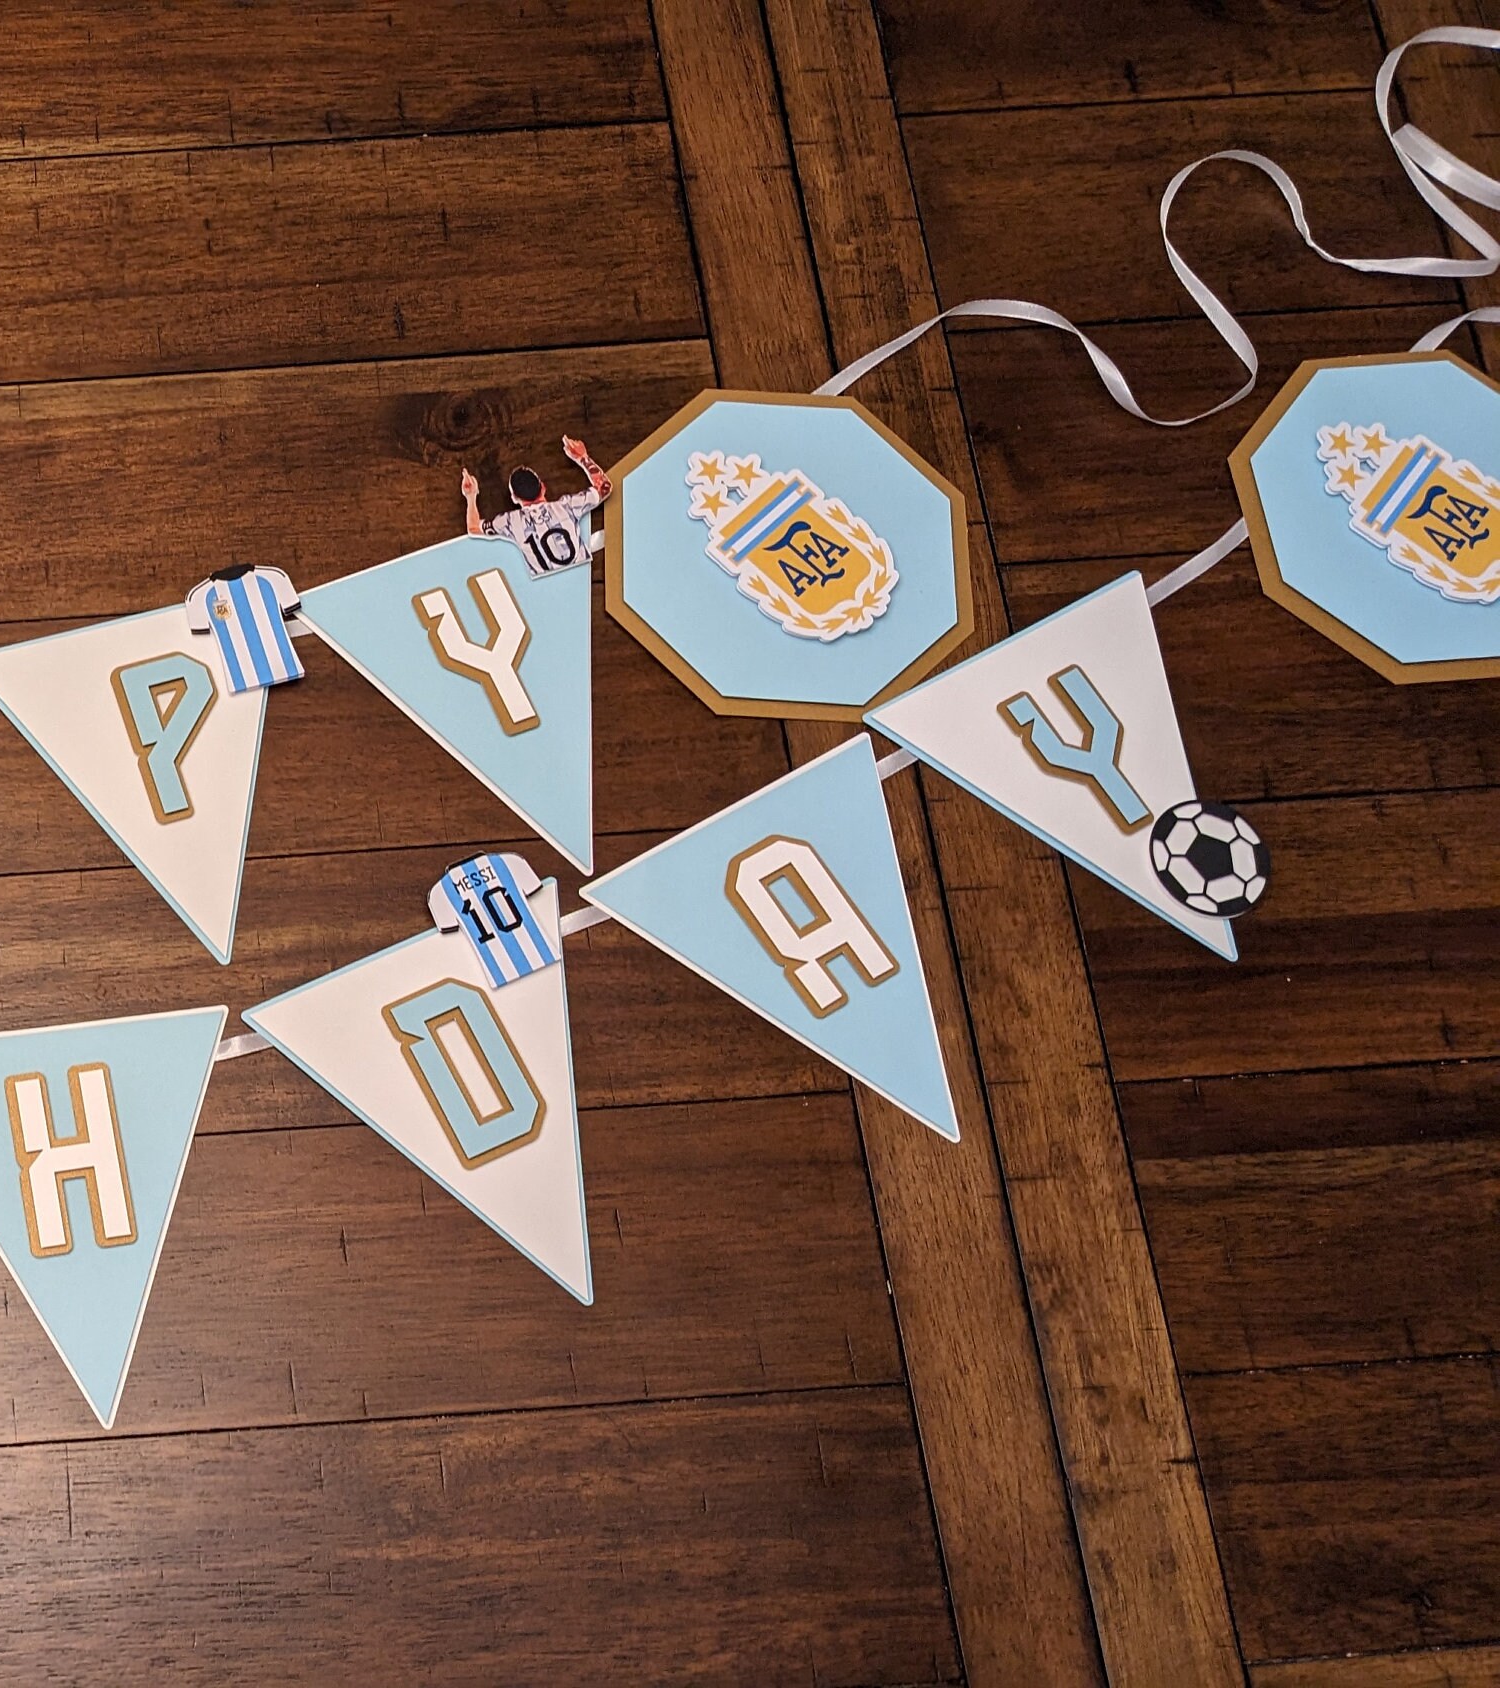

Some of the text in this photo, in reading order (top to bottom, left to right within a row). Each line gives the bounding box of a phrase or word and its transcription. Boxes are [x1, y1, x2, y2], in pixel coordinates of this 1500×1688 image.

[524, 528, 576, 571] 10
[1406, 485, 1490, 562] AFA
[763, 519, 850, 597] AFA
[452, 866, 496, 895] MESSI
[461, 886, 523, 944] 10
